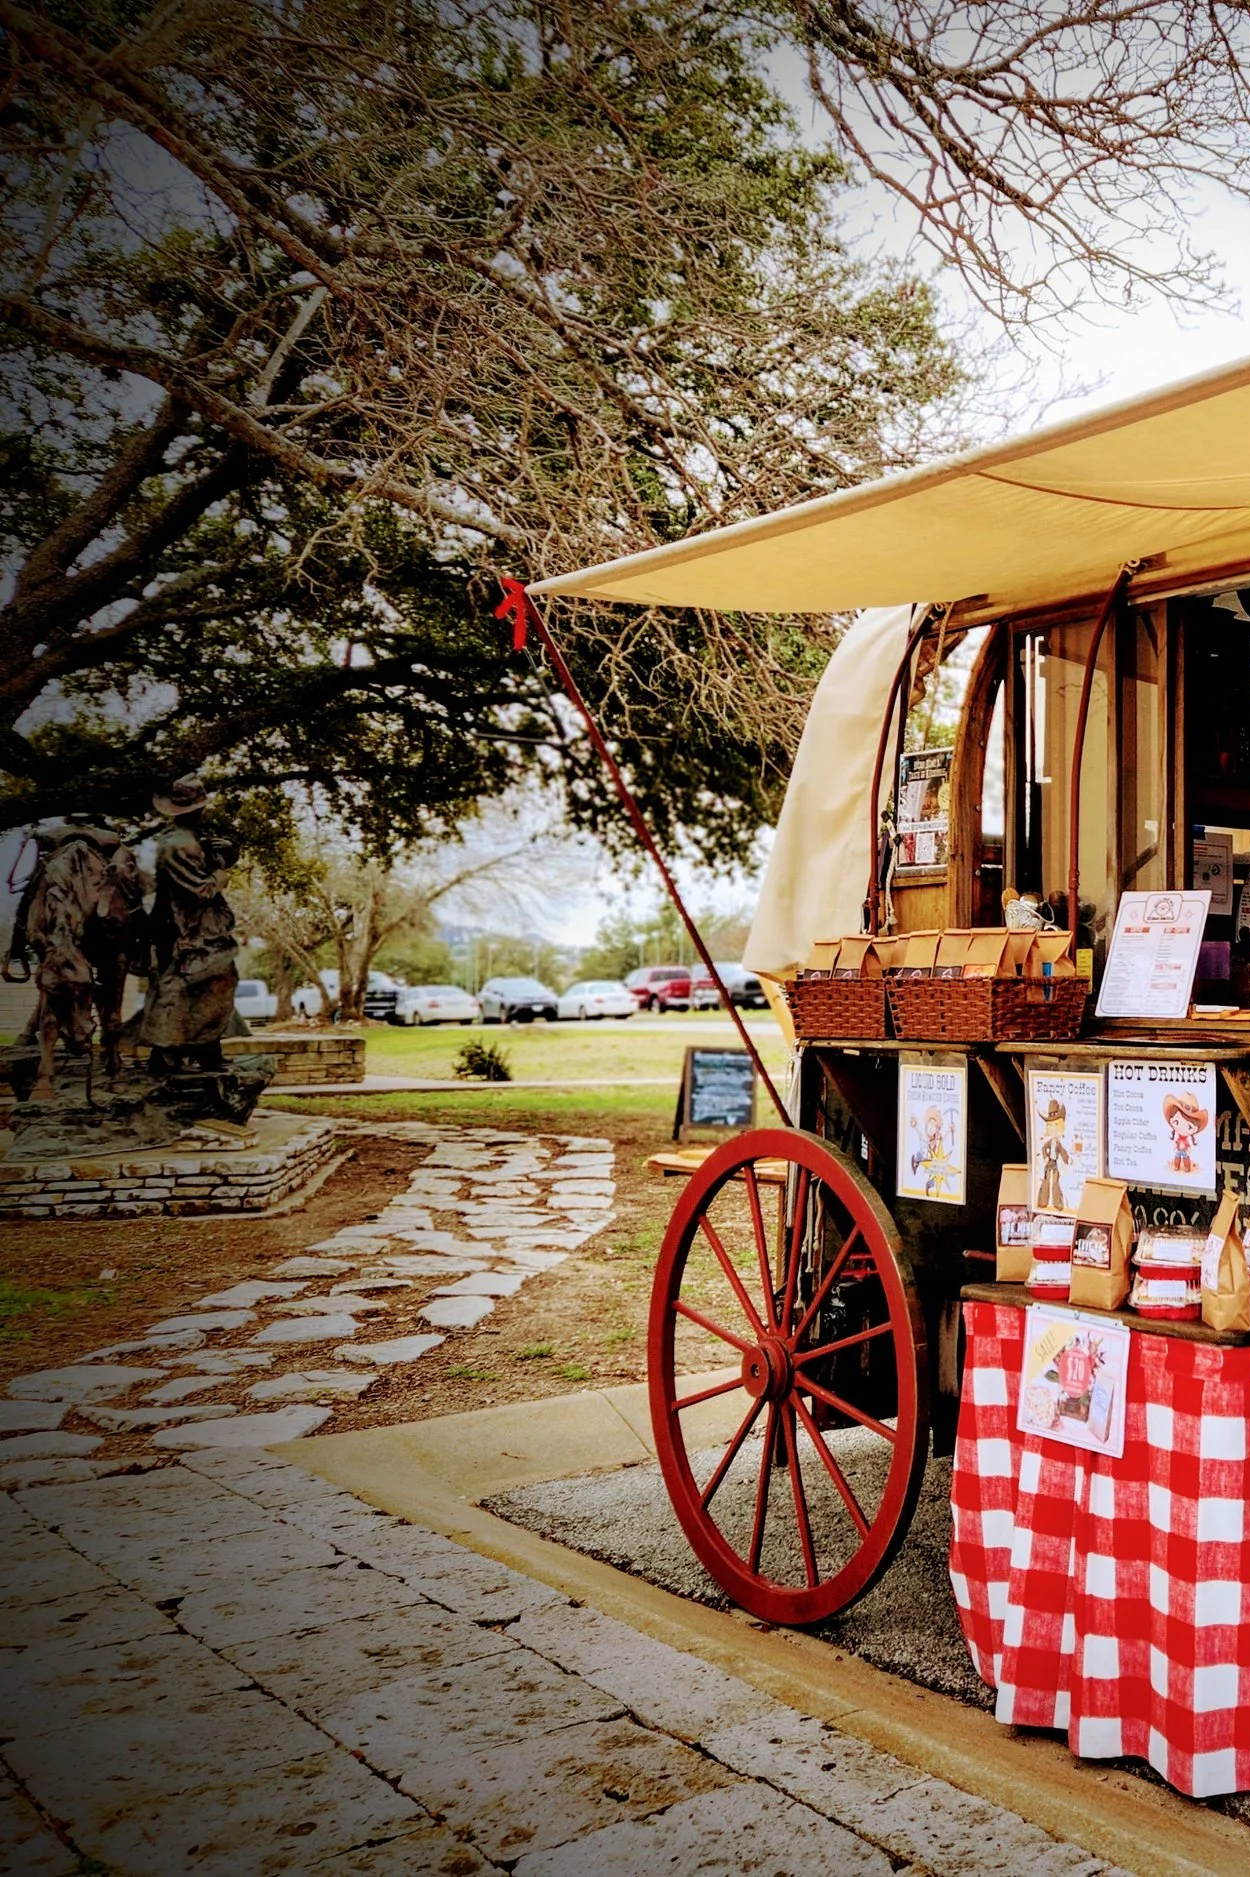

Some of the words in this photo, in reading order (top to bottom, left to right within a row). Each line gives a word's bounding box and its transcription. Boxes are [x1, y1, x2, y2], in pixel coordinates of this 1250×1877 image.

[1114, 1065, 1143, 1080] HOT
[1148, 1066, 1207, 1083] DRINKS
[1037, 1081, 1065, 1095] Fancy
[1068, 1082, 1096, 1095] Coffee
[1067, 1357, 1085, 1381] $20
